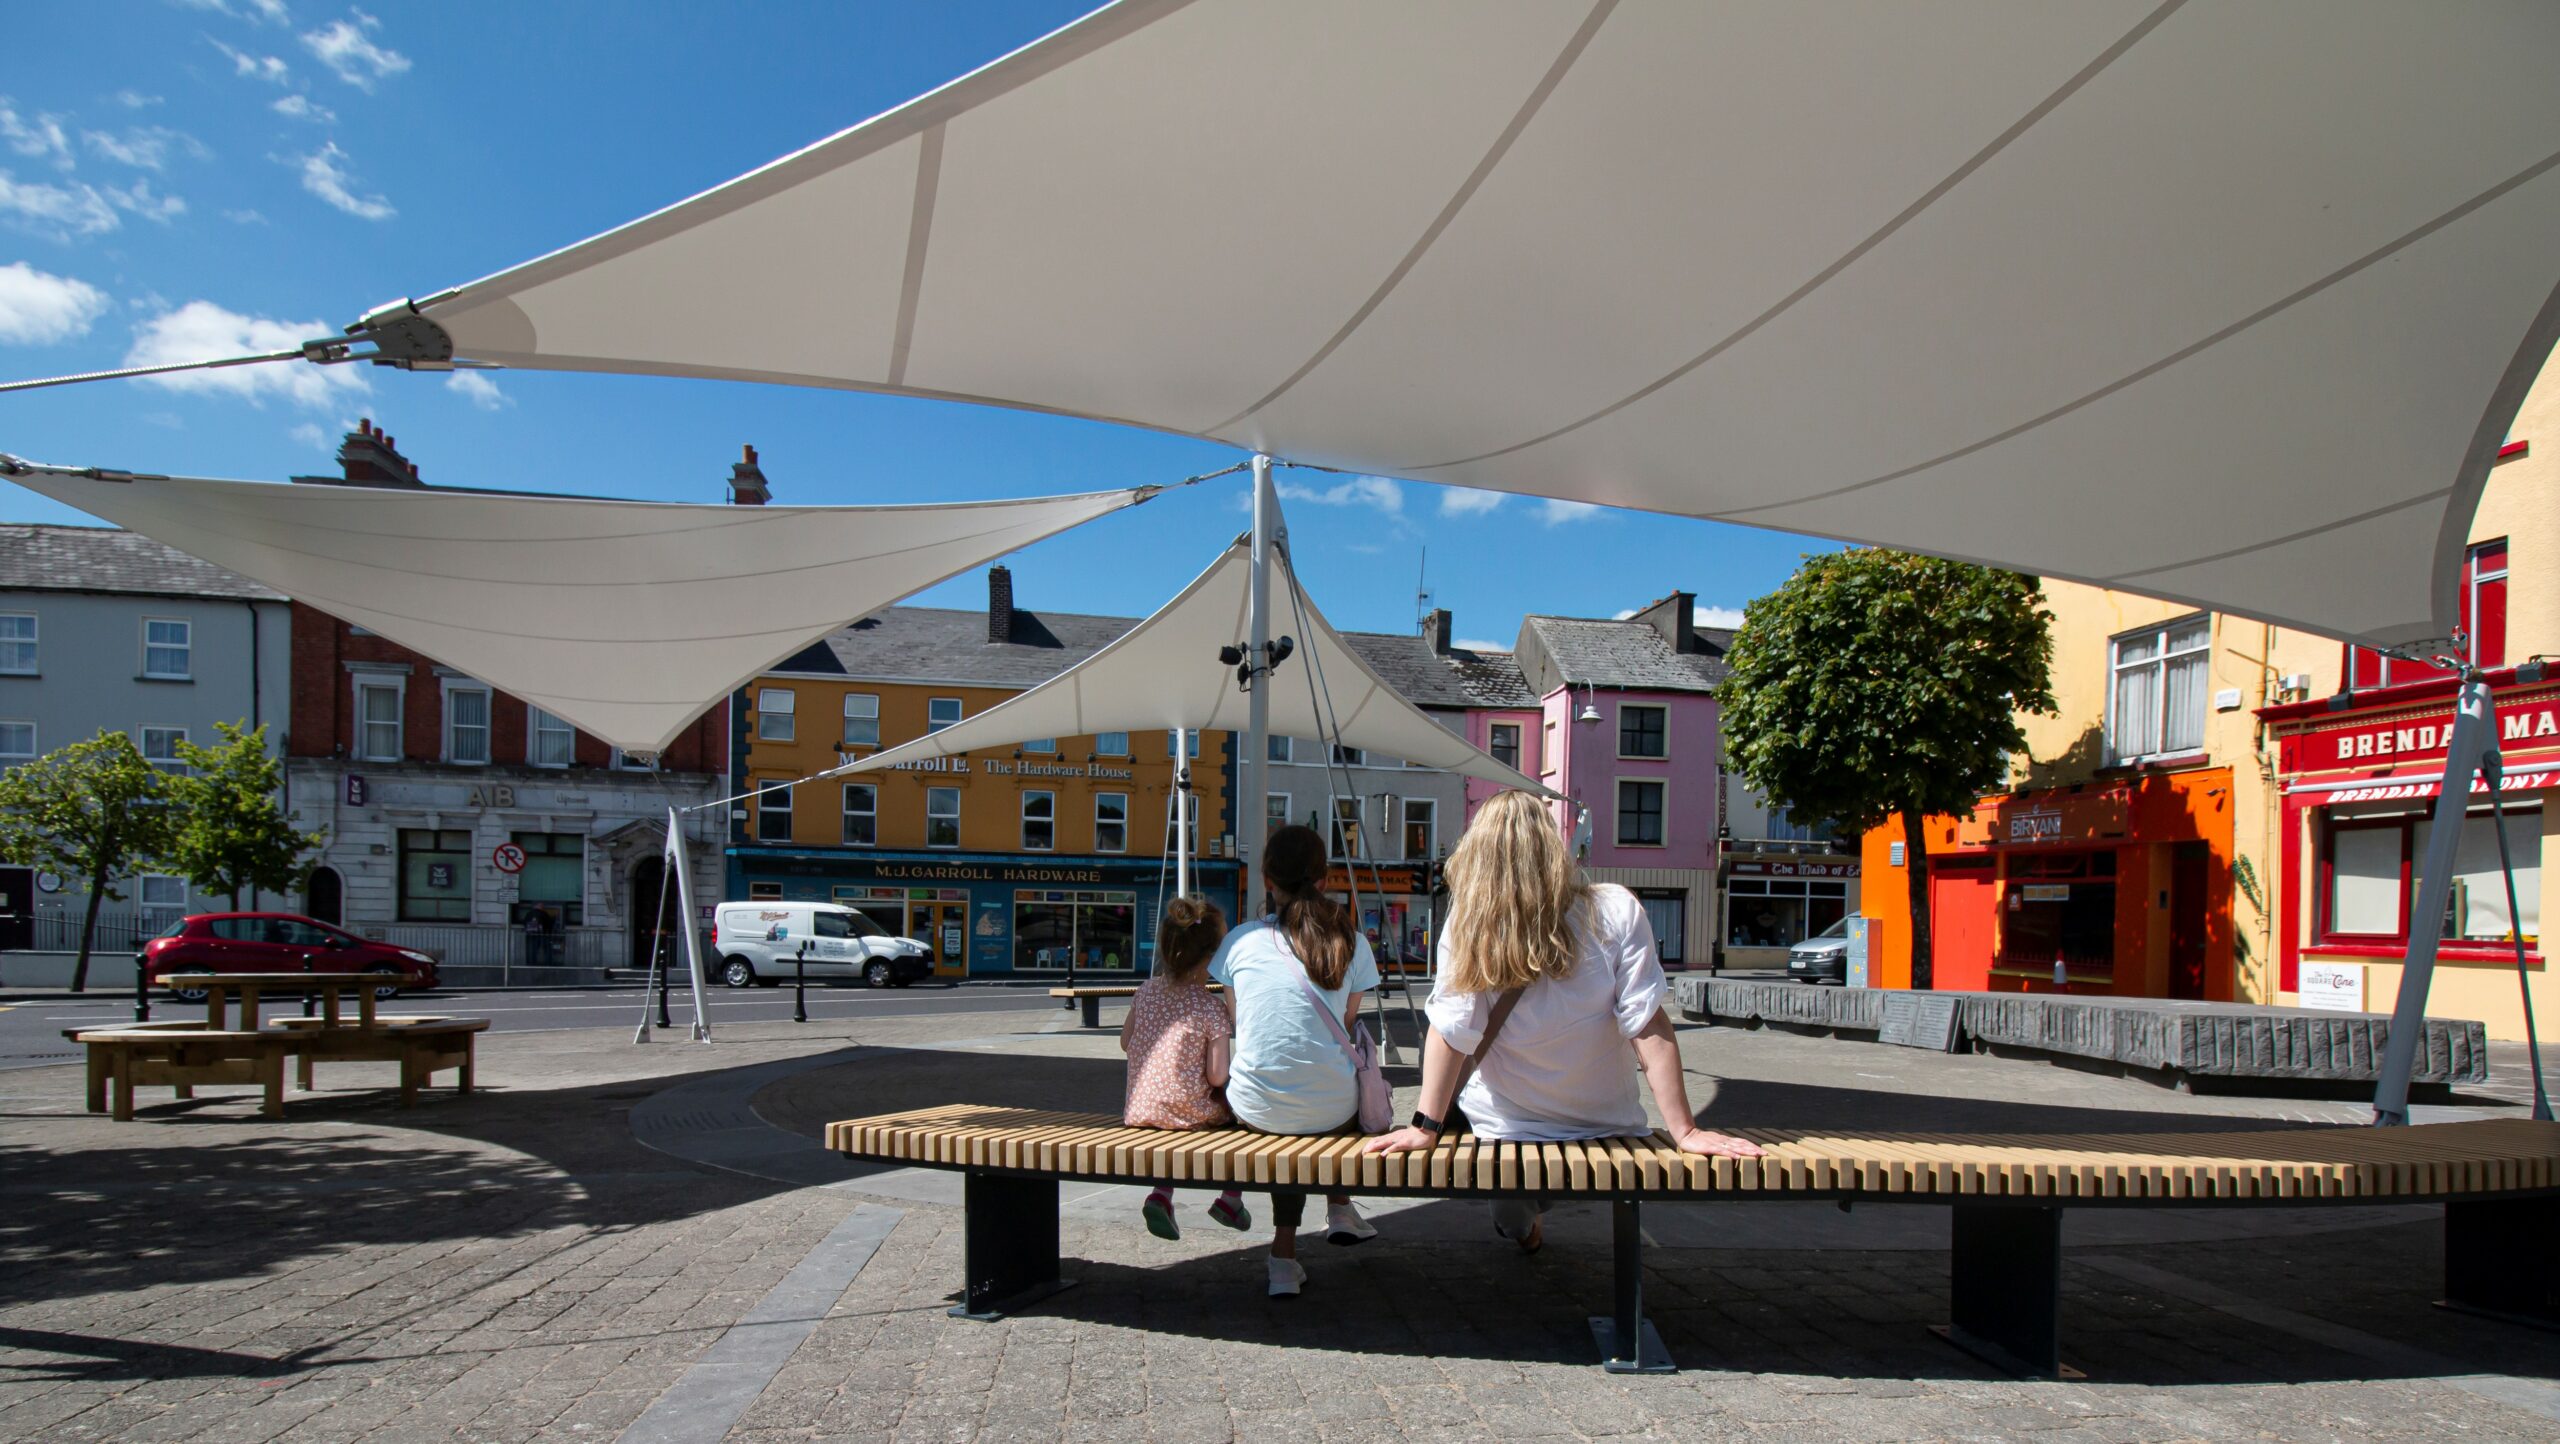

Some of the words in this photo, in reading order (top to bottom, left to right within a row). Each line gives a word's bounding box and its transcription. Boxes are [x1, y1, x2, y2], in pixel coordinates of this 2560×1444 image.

[2337, 724, 2454, 759] BRENDA
[2503, 711, 2558, 740] MA
[885, 757, 947, 772] arroll
[984, 759, 1012, 774] The
[1017, 761, 1084, 776] Hardware
[1087, 763, 1132, 778] House
[469, 785, 515, 807] AIB
[2326, 783, 2434, 803] BRENDAN
[2011, 816, 2062, 837] BIRYANI
[1004, 868, 1101, 882] HARDWARE
[1357, 874, 1413, 885] PHARMAC
[1771, 863, 1794, 875] The
[1799, 863, 1827, 876] Maid
[1832, 865, 1843, 876] of
[1847, 865, 1861, 877] Er
